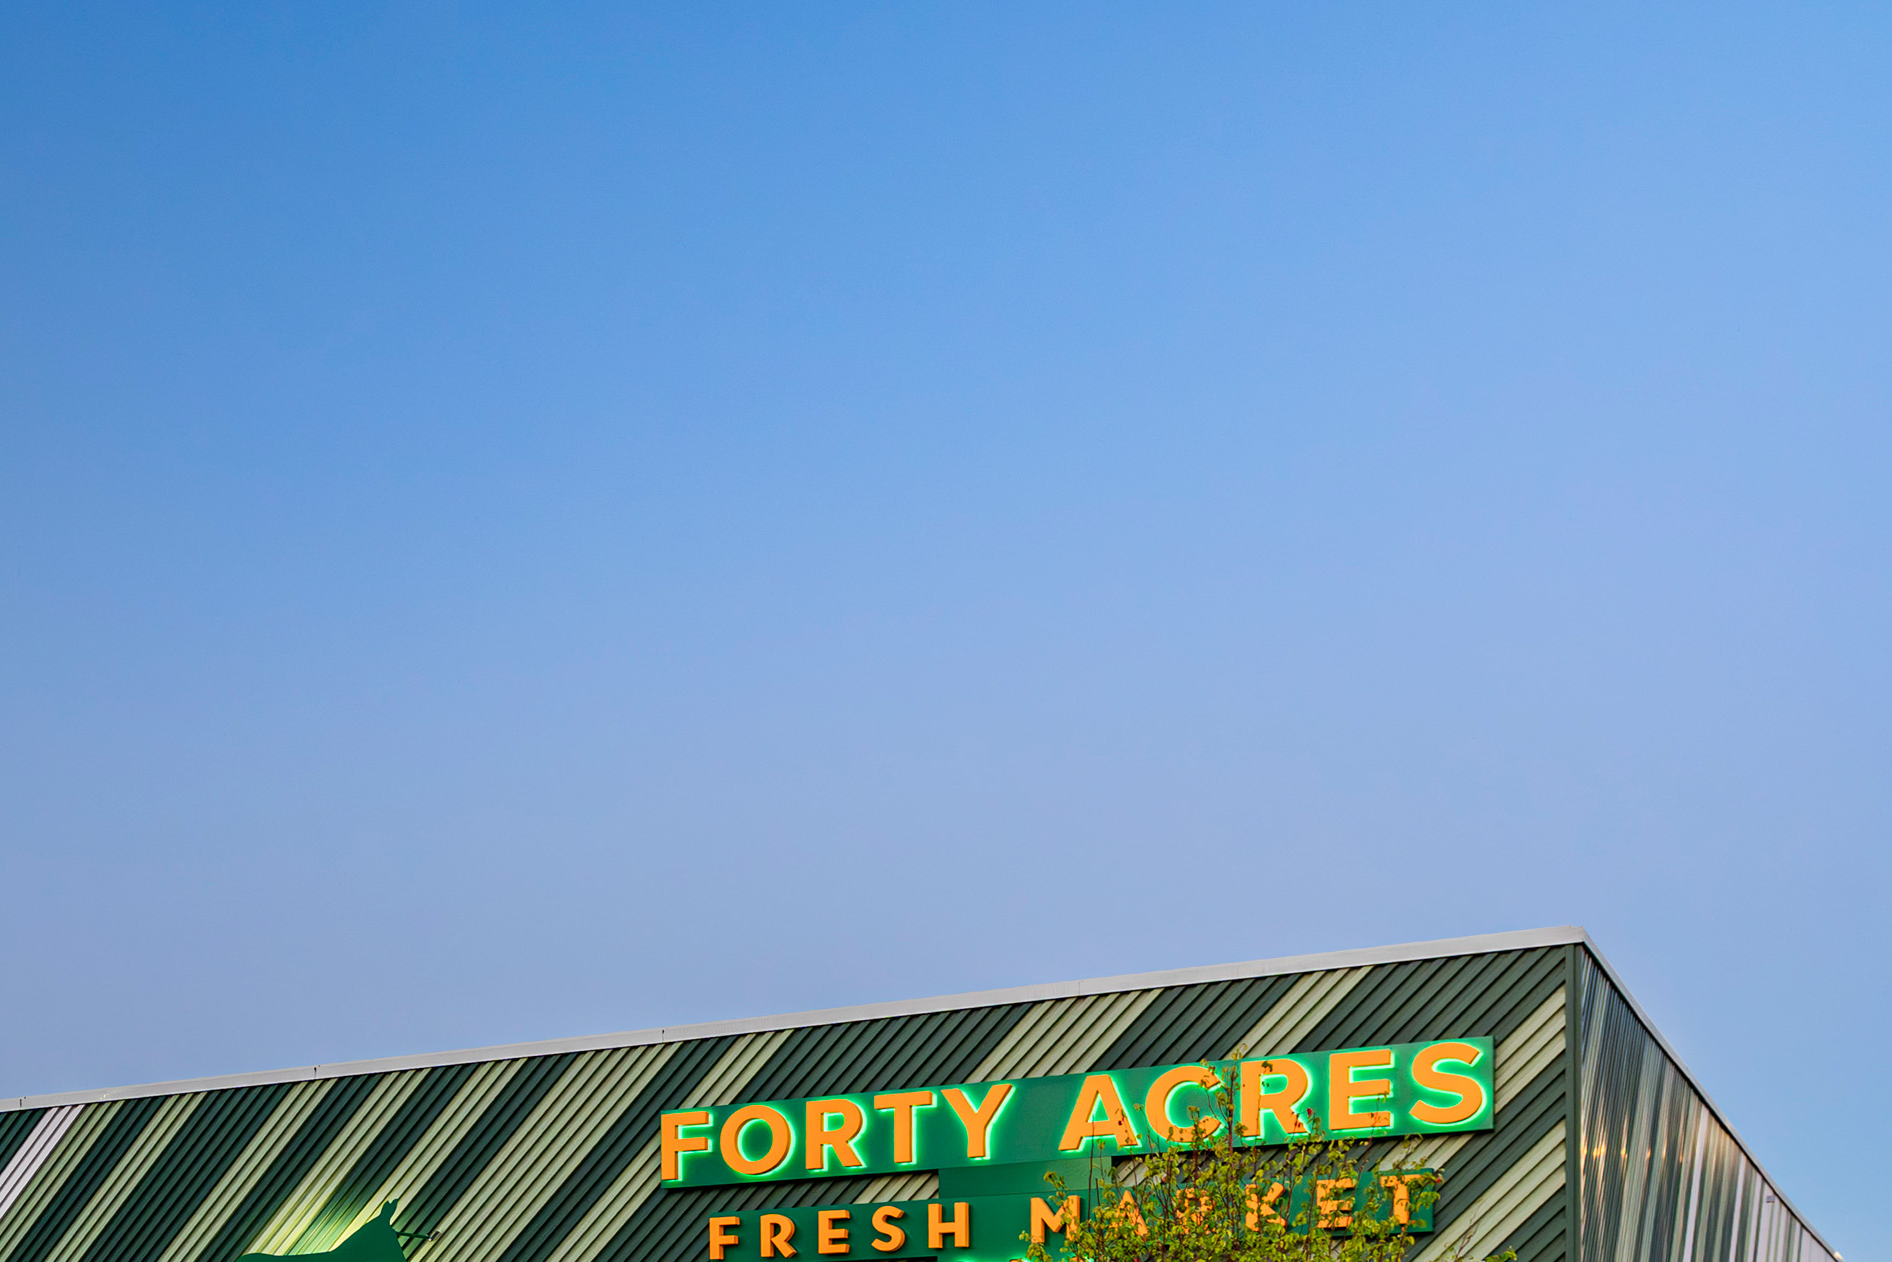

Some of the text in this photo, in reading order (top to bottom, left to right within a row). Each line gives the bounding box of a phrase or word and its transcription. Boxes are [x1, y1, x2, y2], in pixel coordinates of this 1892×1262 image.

[660, 1042, 1485, 1181] FORTY ACRES
[709, 1202, 970, 1260] FRESH
